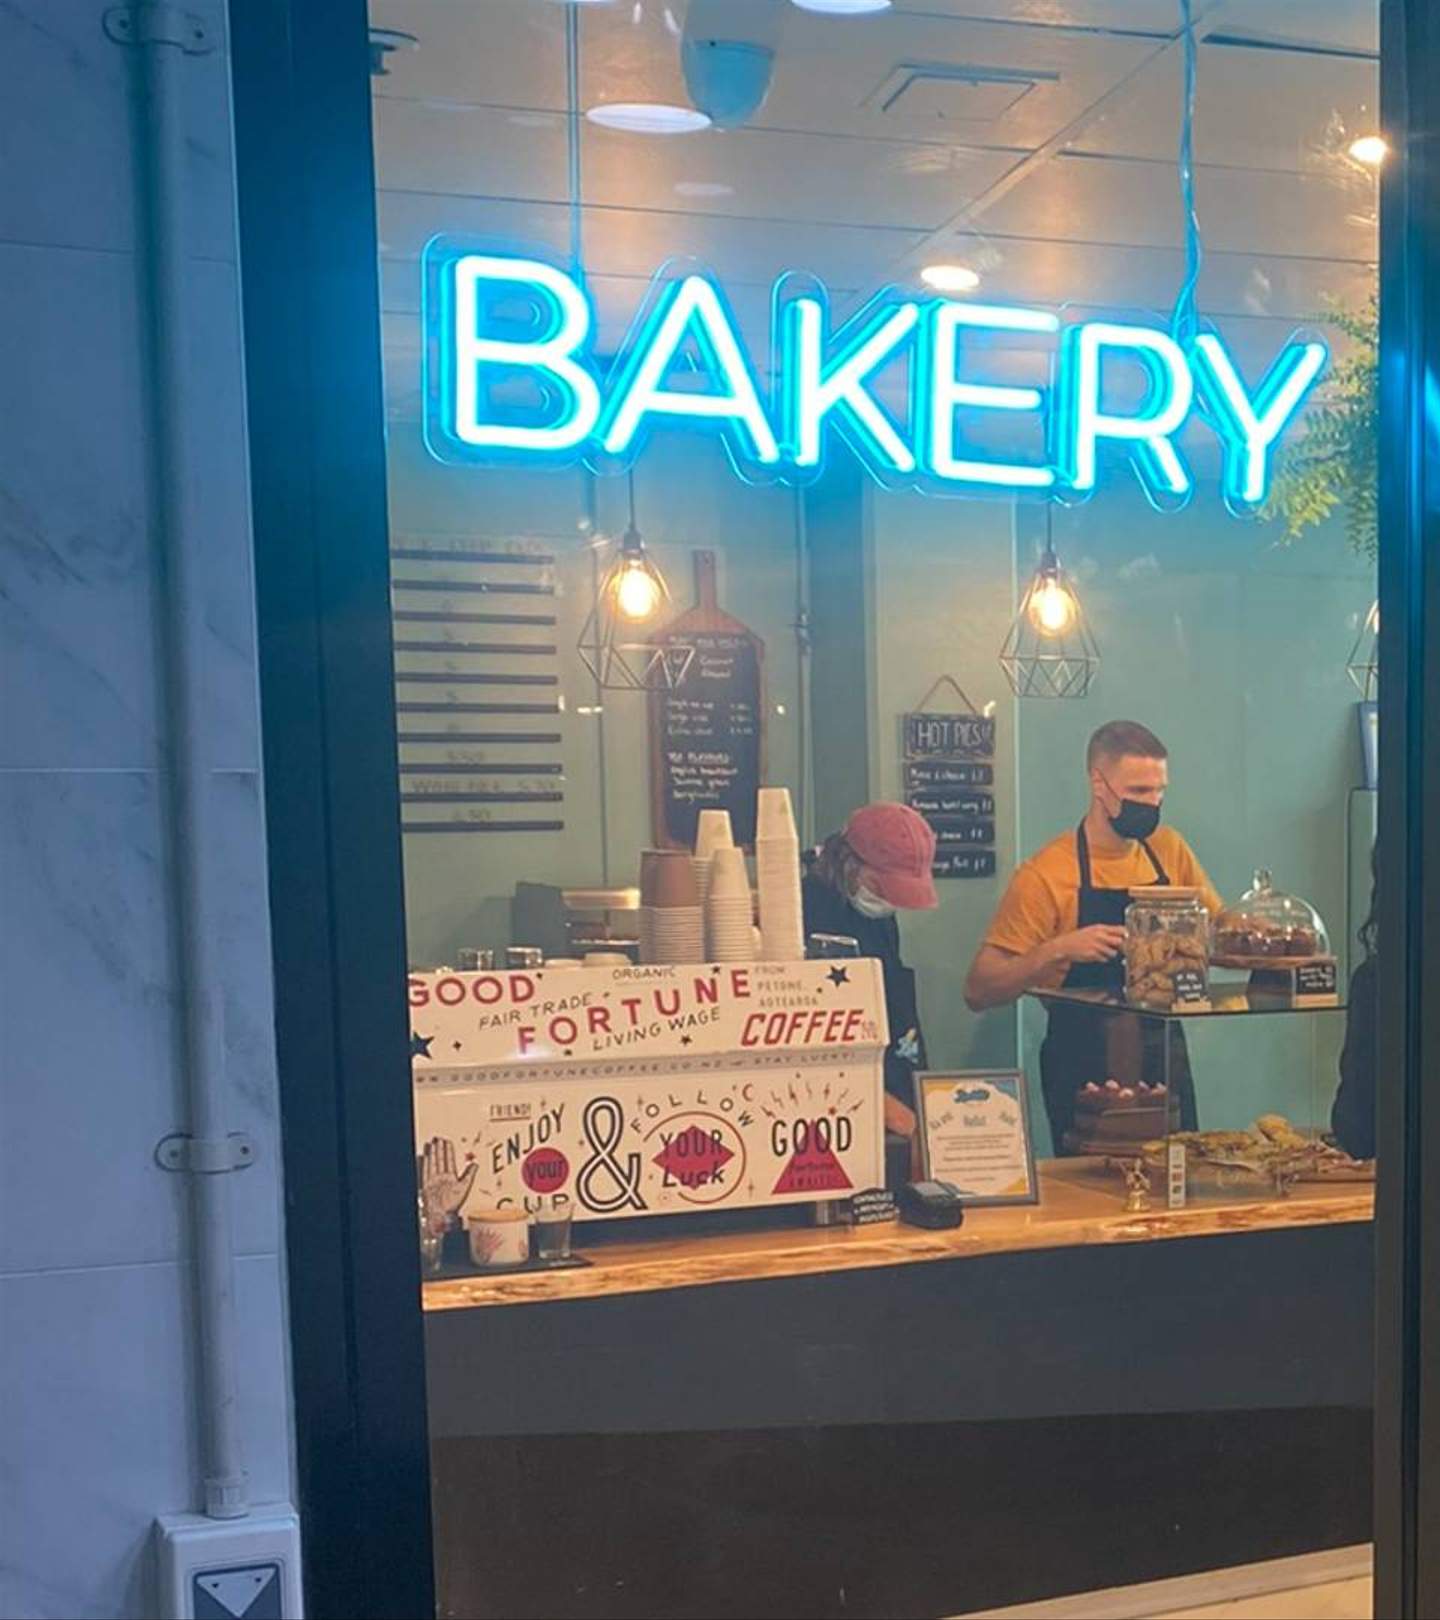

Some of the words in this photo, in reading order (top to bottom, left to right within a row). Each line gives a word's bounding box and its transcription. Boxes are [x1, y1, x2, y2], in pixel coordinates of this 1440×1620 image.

[446, 252, 1328, 505] BAKERY
[918, 721, 949, 747] HOT
[612, 966, 676, 980] ORGANIC
[755, 965, 785, 975] FROM
[409, 974, 536, 1007] GOOD
[479, 1009, 522, 1030] FAIR
[531, 992, 592, 1016] TRADE
[517, 968, 752, 1055] FORTUNE
[592, 1021, 662, 1051] LIVING
[667, 1006, 721, 1032] WAGE
[739, 1008, 864, 1048] COFFEE
[630, 1089, 756, 1134] FOLLOW
[491, 1102, 566, 1174] ENJOY
[576, 1095, 648, 1213] &
[660, 1129, 724, 1158] YOUR
[772, 1116, 852, 1157] GOOD
